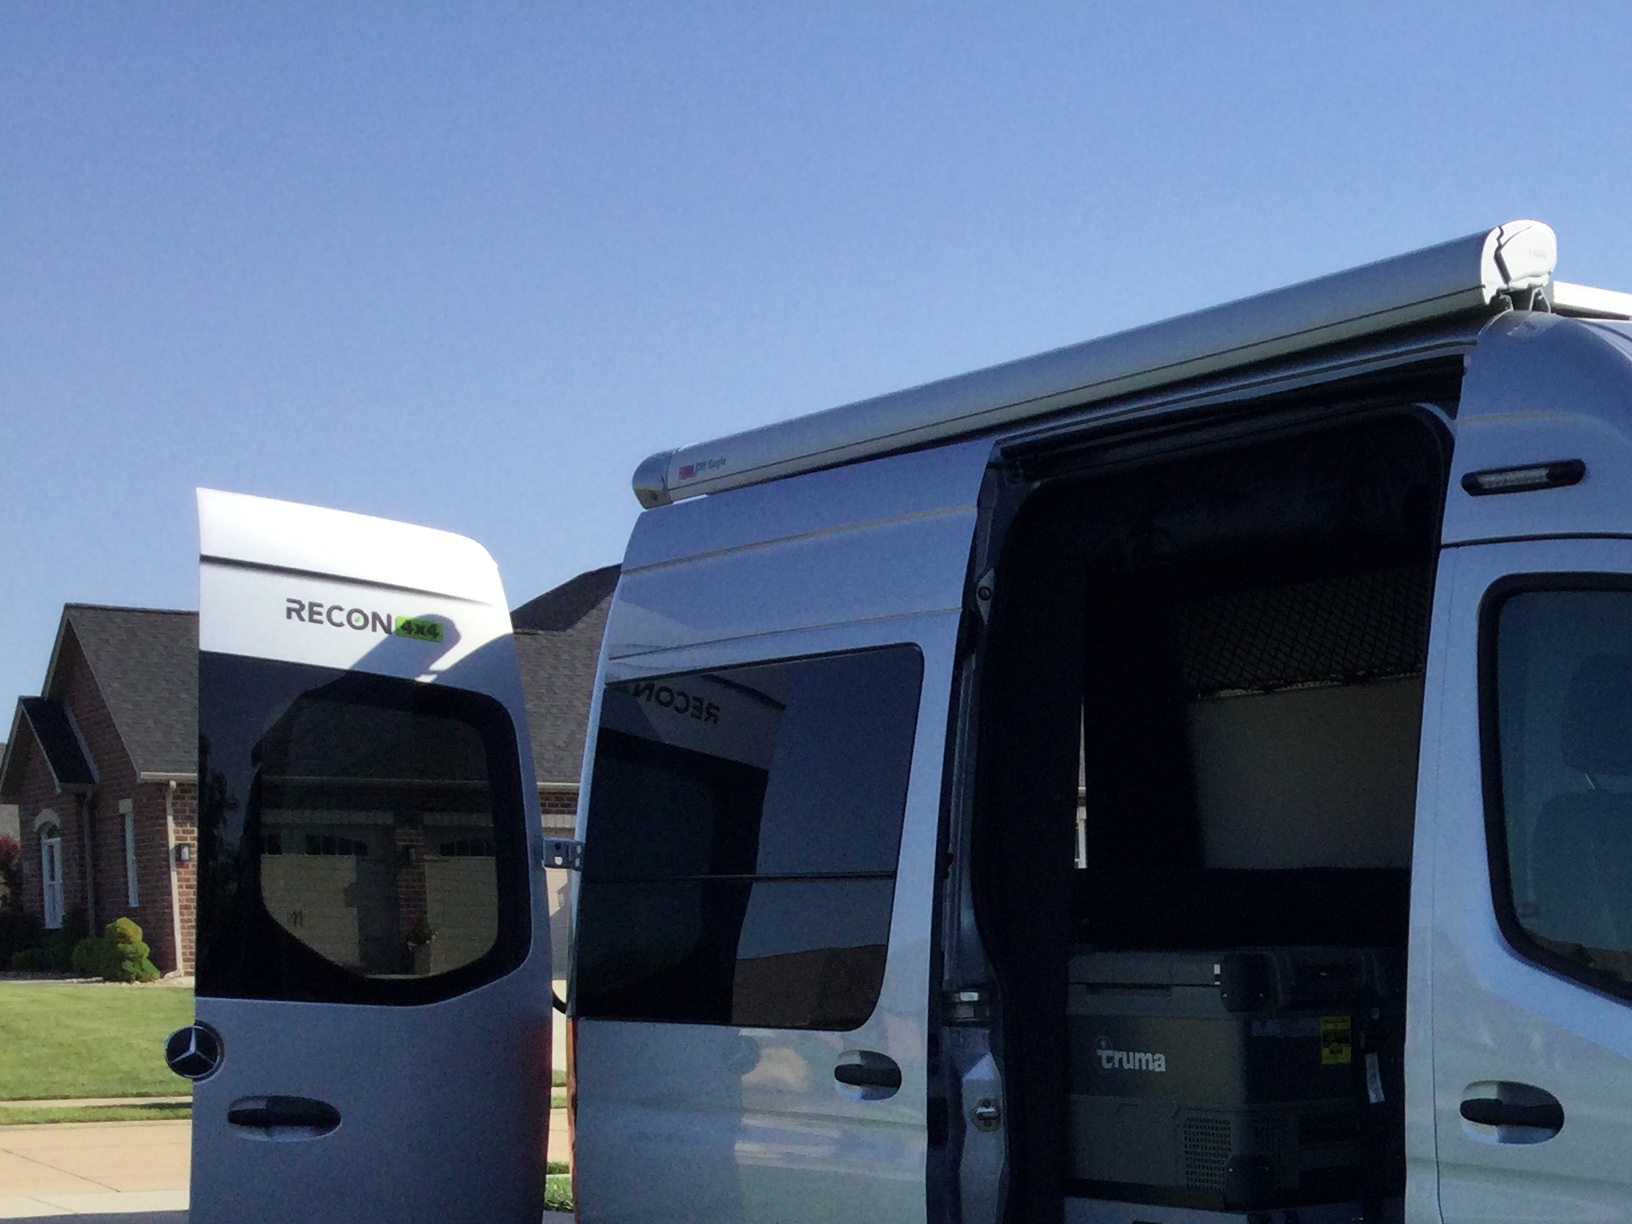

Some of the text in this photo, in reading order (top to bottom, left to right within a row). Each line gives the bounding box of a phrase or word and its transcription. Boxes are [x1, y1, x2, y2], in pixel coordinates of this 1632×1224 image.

[286, 598, 440, 639] RECON 4x4
[1097, 1049, 1167, 1073] truma
